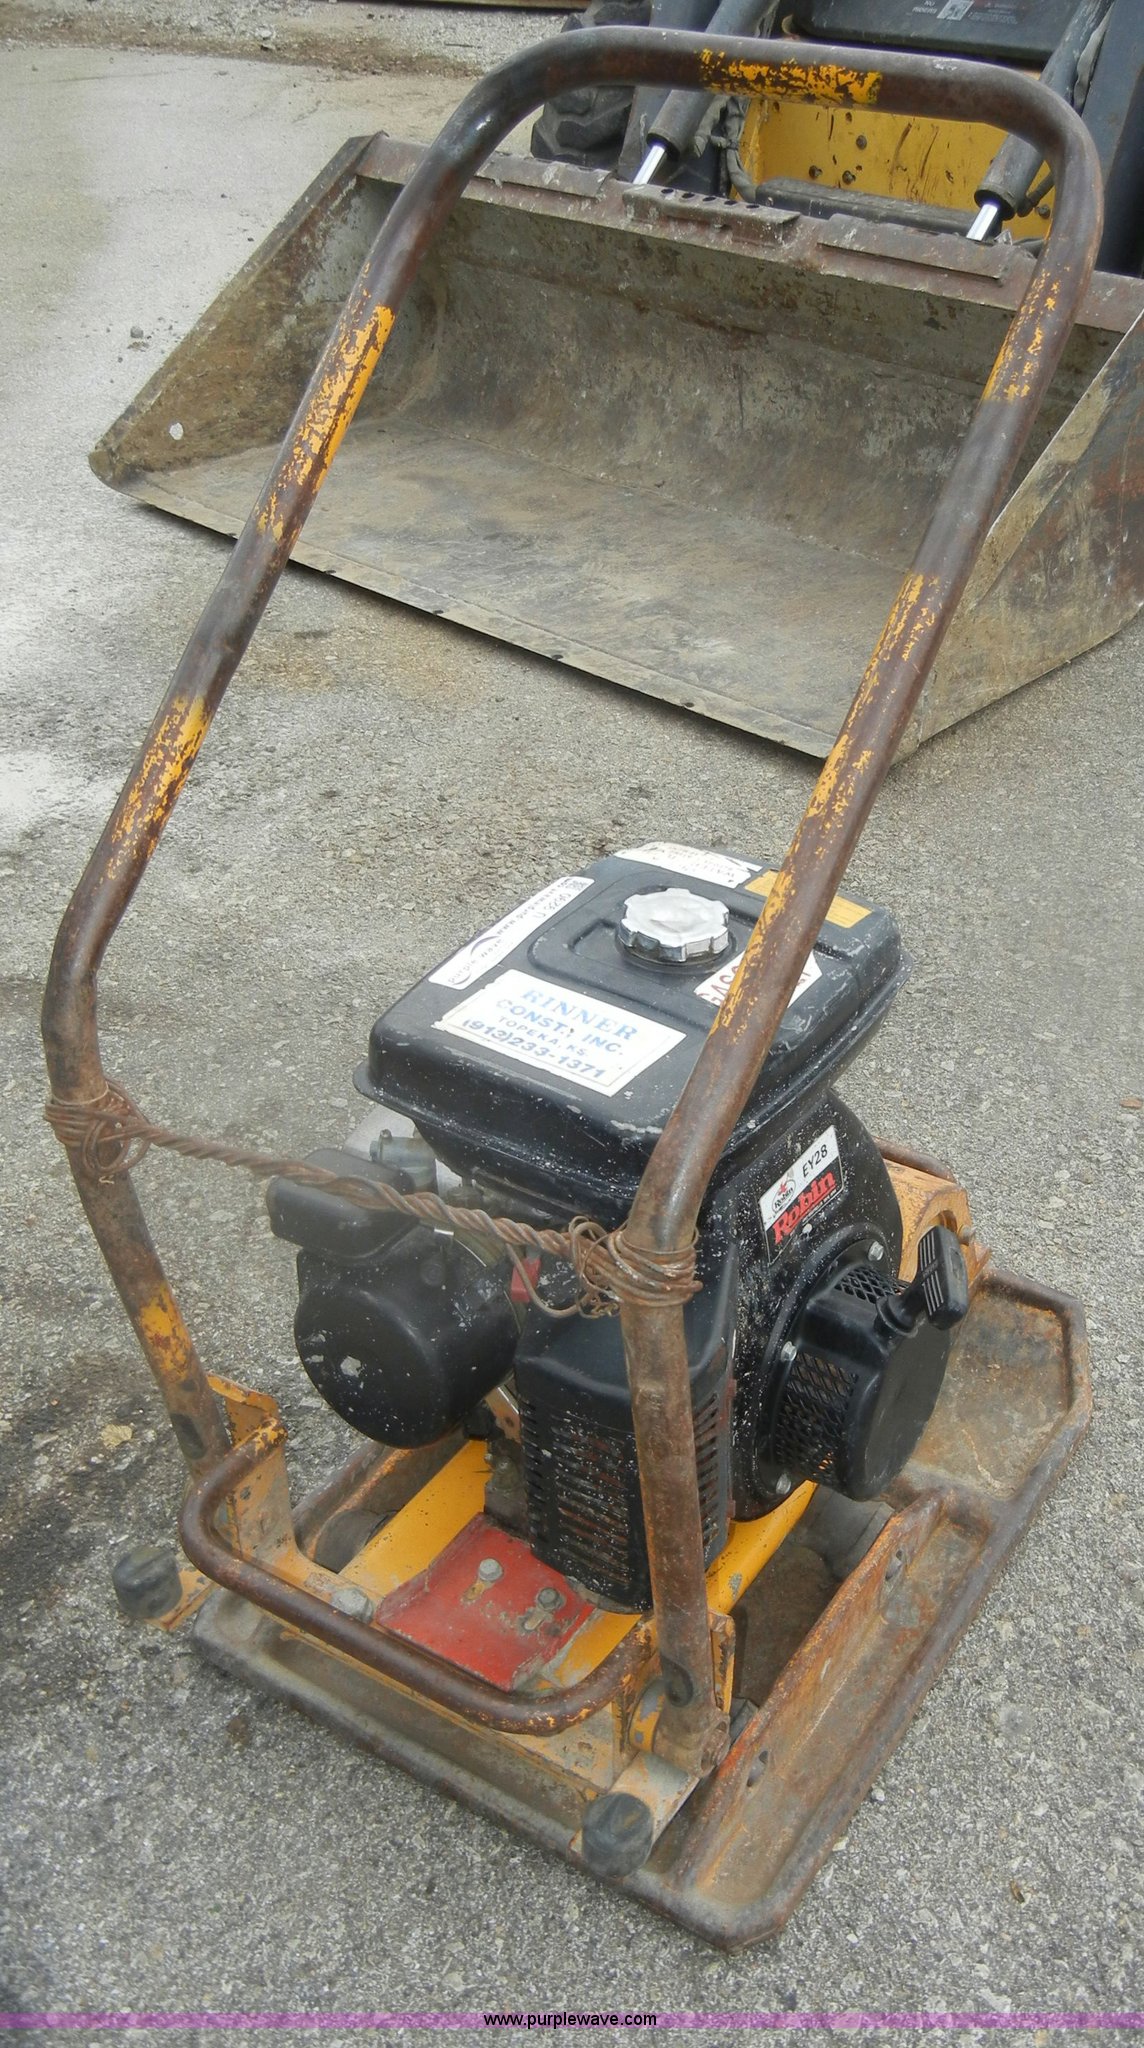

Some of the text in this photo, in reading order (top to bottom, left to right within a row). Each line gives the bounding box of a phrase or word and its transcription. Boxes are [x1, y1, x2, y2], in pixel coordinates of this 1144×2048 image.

[462, 1019, 607, 1078] (913)233-1371
[582, 1033, 624, 1055] INC.
[802, 1144, 828, 1178] EY28
[772, 1171, 836, 1245] Robin
